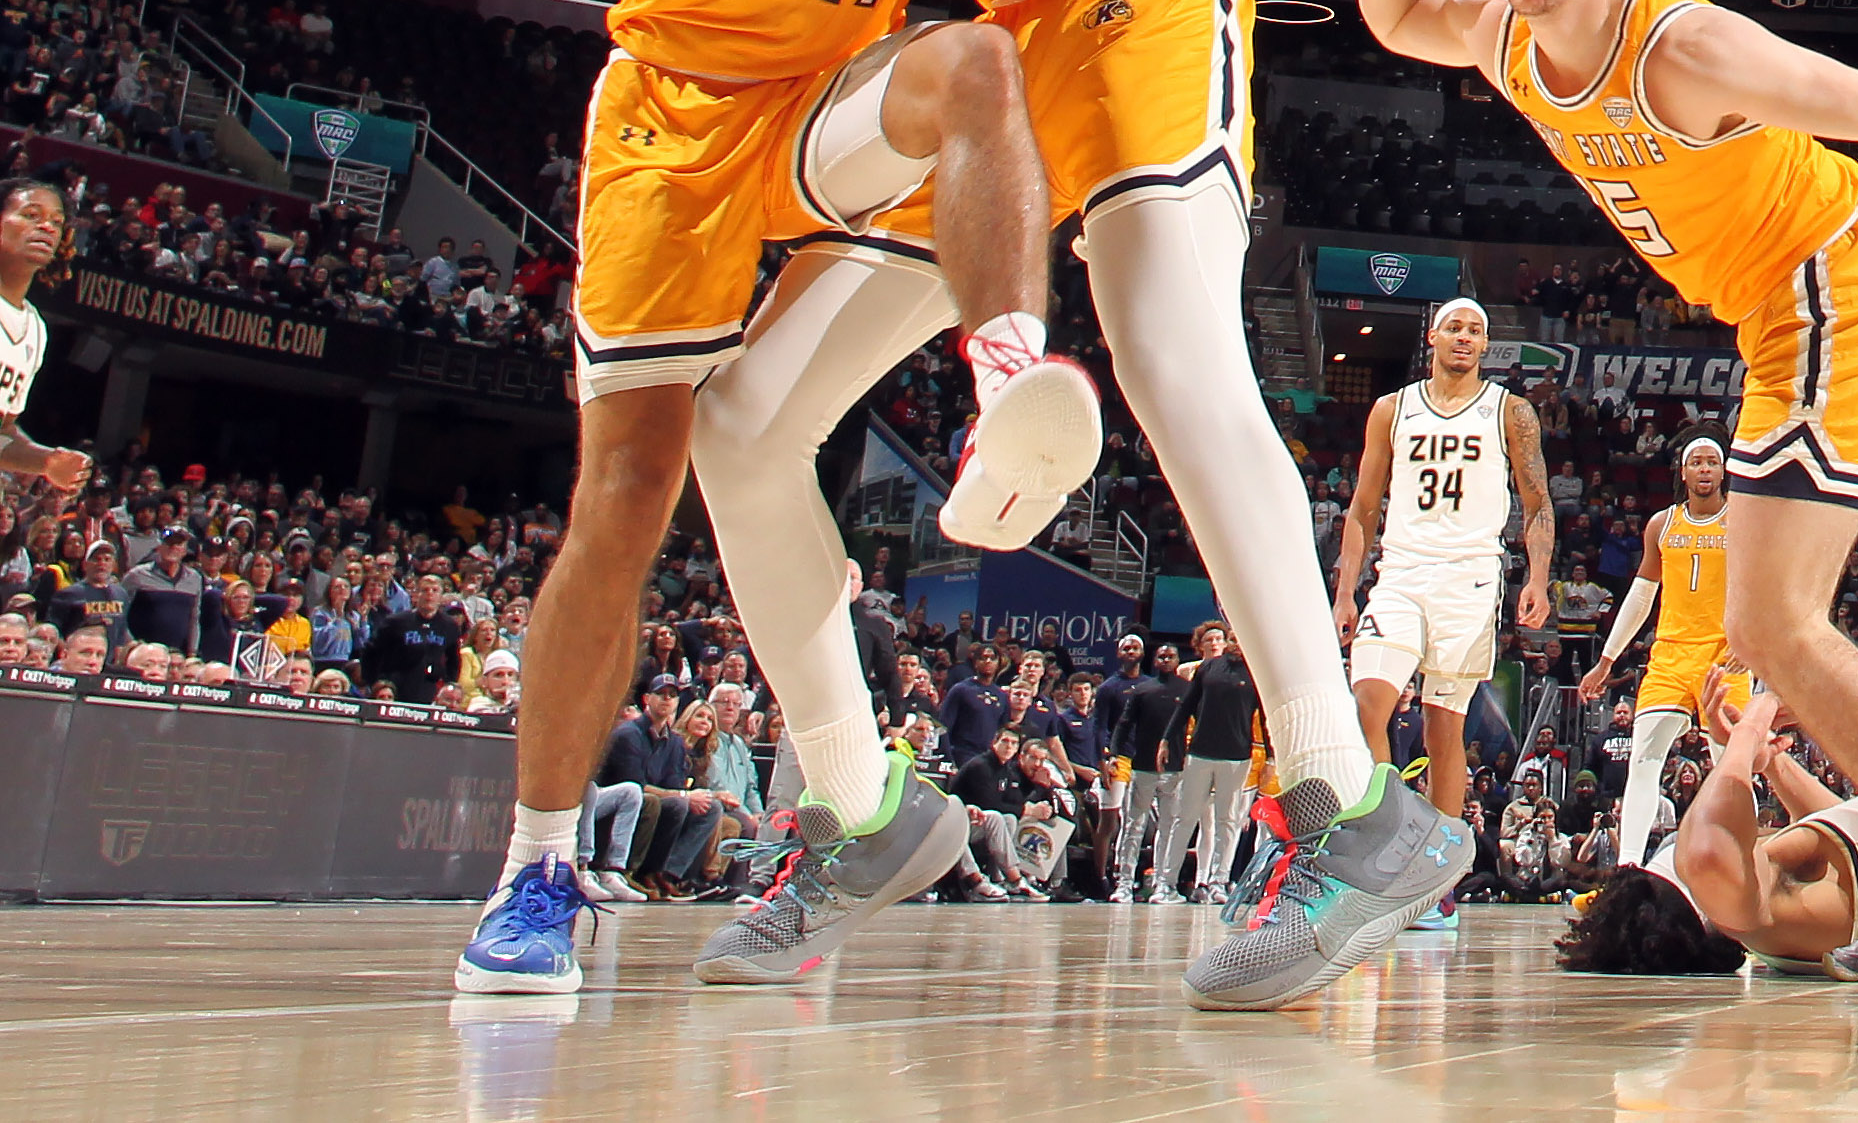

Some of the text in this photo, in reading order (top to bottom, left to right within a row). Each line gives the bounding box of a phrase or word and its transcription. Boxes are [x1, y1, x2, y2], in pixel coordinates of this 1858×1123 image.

[318, 124, 353, 142] MAC
[1573, 132, 1667, 167] STATE
[1574, 174, 1679, 258] 5
[1375, 265, 1407, 279] MAC
[76, 269, 328, 359] VISIT US AT SPALDING.COM
[1482, 346, 1516, 360] 946
[1593, 353, 1749, 398] WELCO
[1409, 434, 1482, 462] ZIPS
[1417, 467, 1464, 513] 34
[1690, 552, 1700, 592] 1
[84, 601, 124, 615] KENT
[1354, 614, 1384, 638] A
